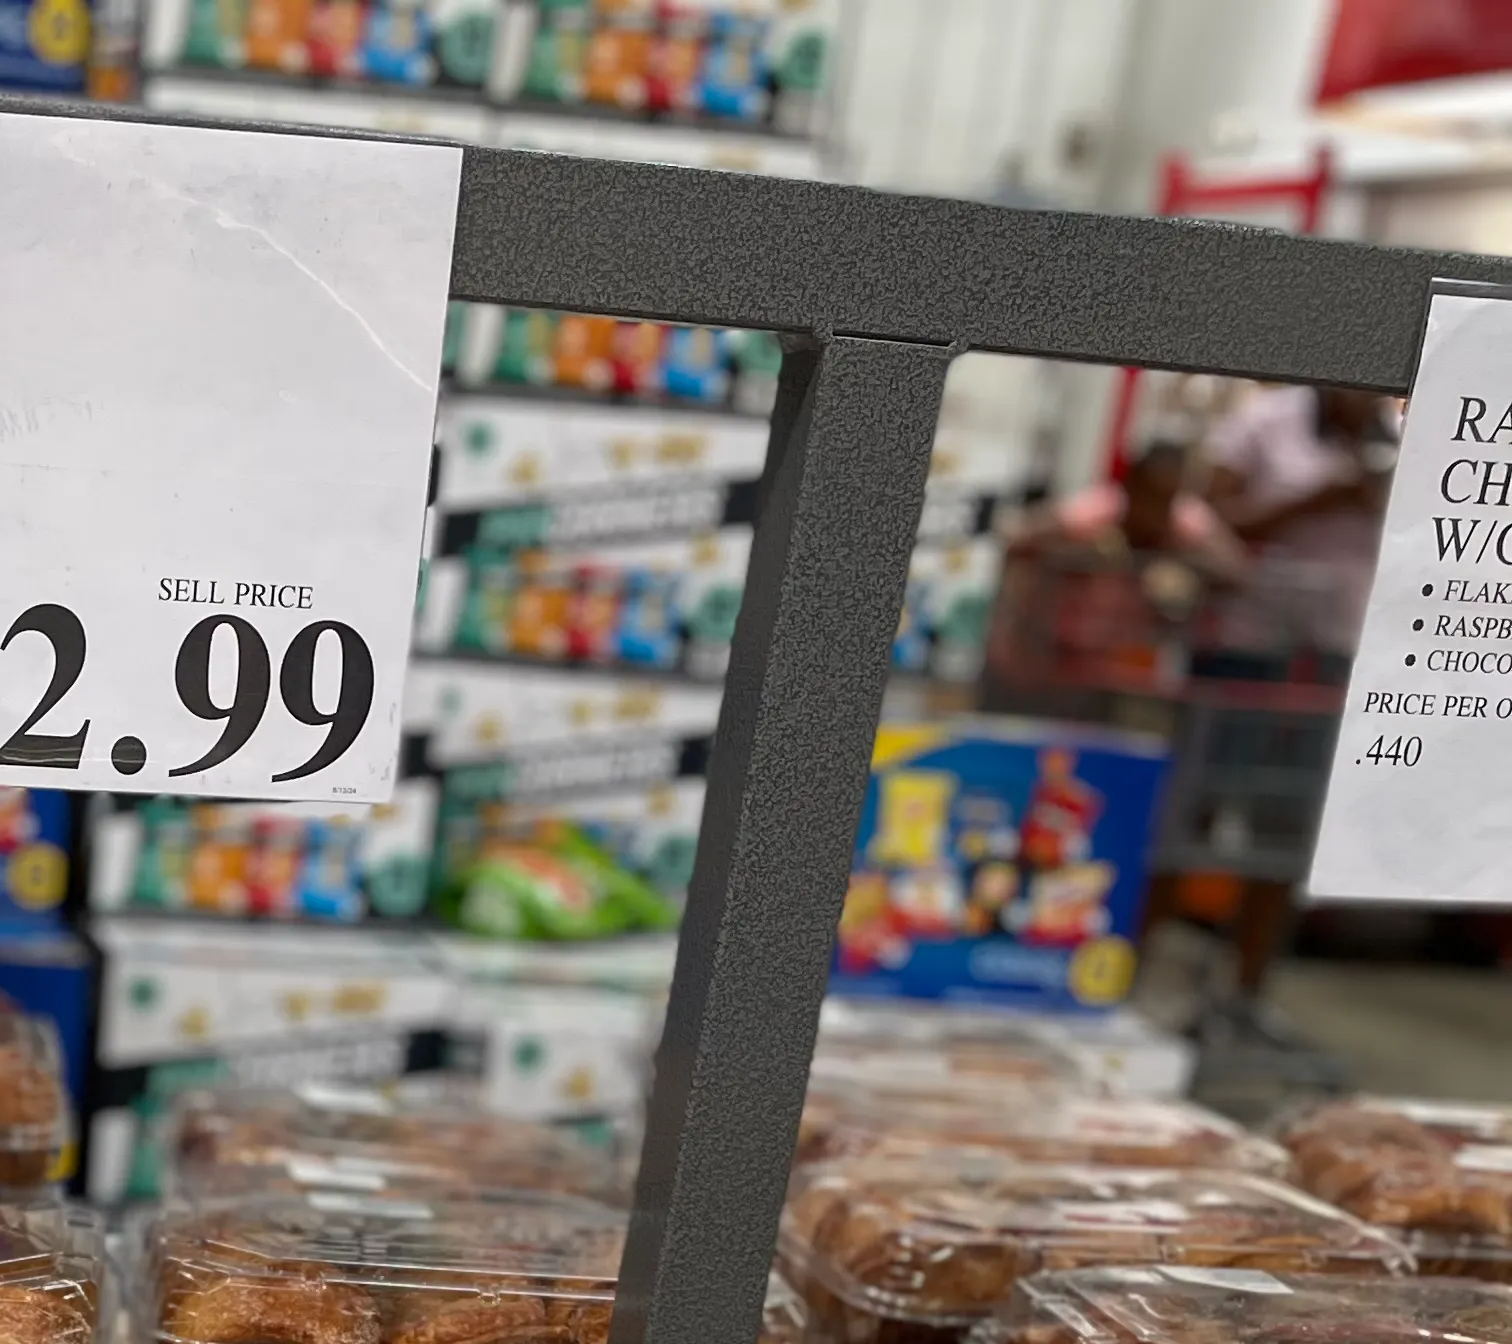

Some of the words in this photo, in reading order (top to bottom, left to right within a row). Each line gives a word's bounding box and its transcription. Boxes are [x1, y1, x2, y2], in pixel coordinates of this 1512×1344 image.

[159, 579, 224, 603] SELL
[235, 583, 312, 608] PRICE
[1363, 692, 1436, 715] PRICE
[1442, 695, 1487, 718] PER
[1356, 735, 1422, 767] .440
